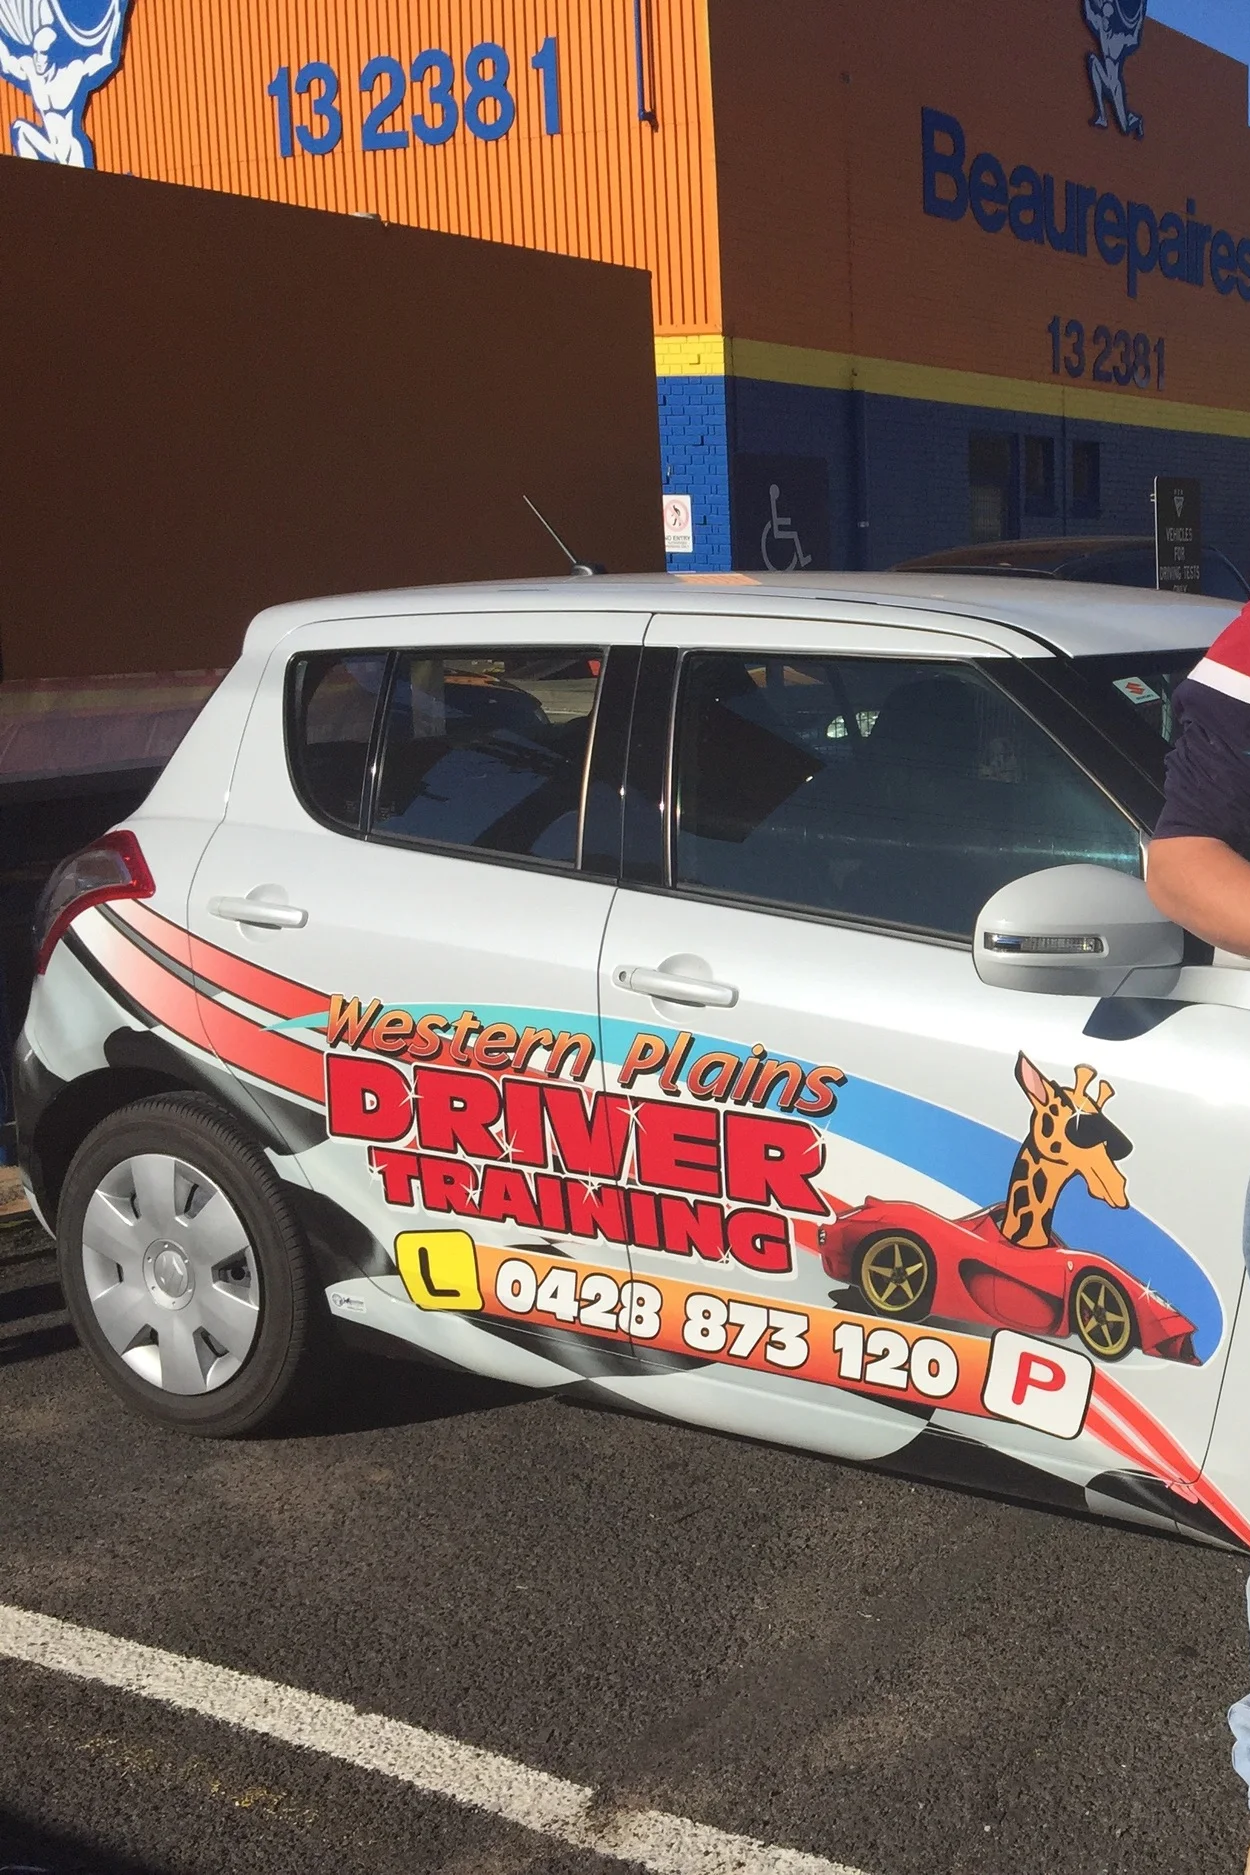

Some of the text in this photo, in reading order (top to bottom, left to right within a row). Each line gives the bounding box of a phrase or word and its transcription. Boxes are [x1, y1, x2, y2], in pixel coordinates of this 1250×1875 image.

[268, 36, 560, 158] 13 2381
[1048, 315, 1166, 390] 13 2381
[1165, 527, 1193, 541] VEHICLES
[1173, 546, 1186, 561] FOR
[1160, 565, 1200, 580] DRIVING TESTS
[326, 993, 848, 1116] Western Plains
[326, 1054, 834, 1216] DRIVER
[368, 1147, 793, 1273] TRAINING
[417, 1247, 462, 1298] L
[495, 1261, 959, 1399] 0428 873 120
[1012, 1351, 1066, 1405] P
